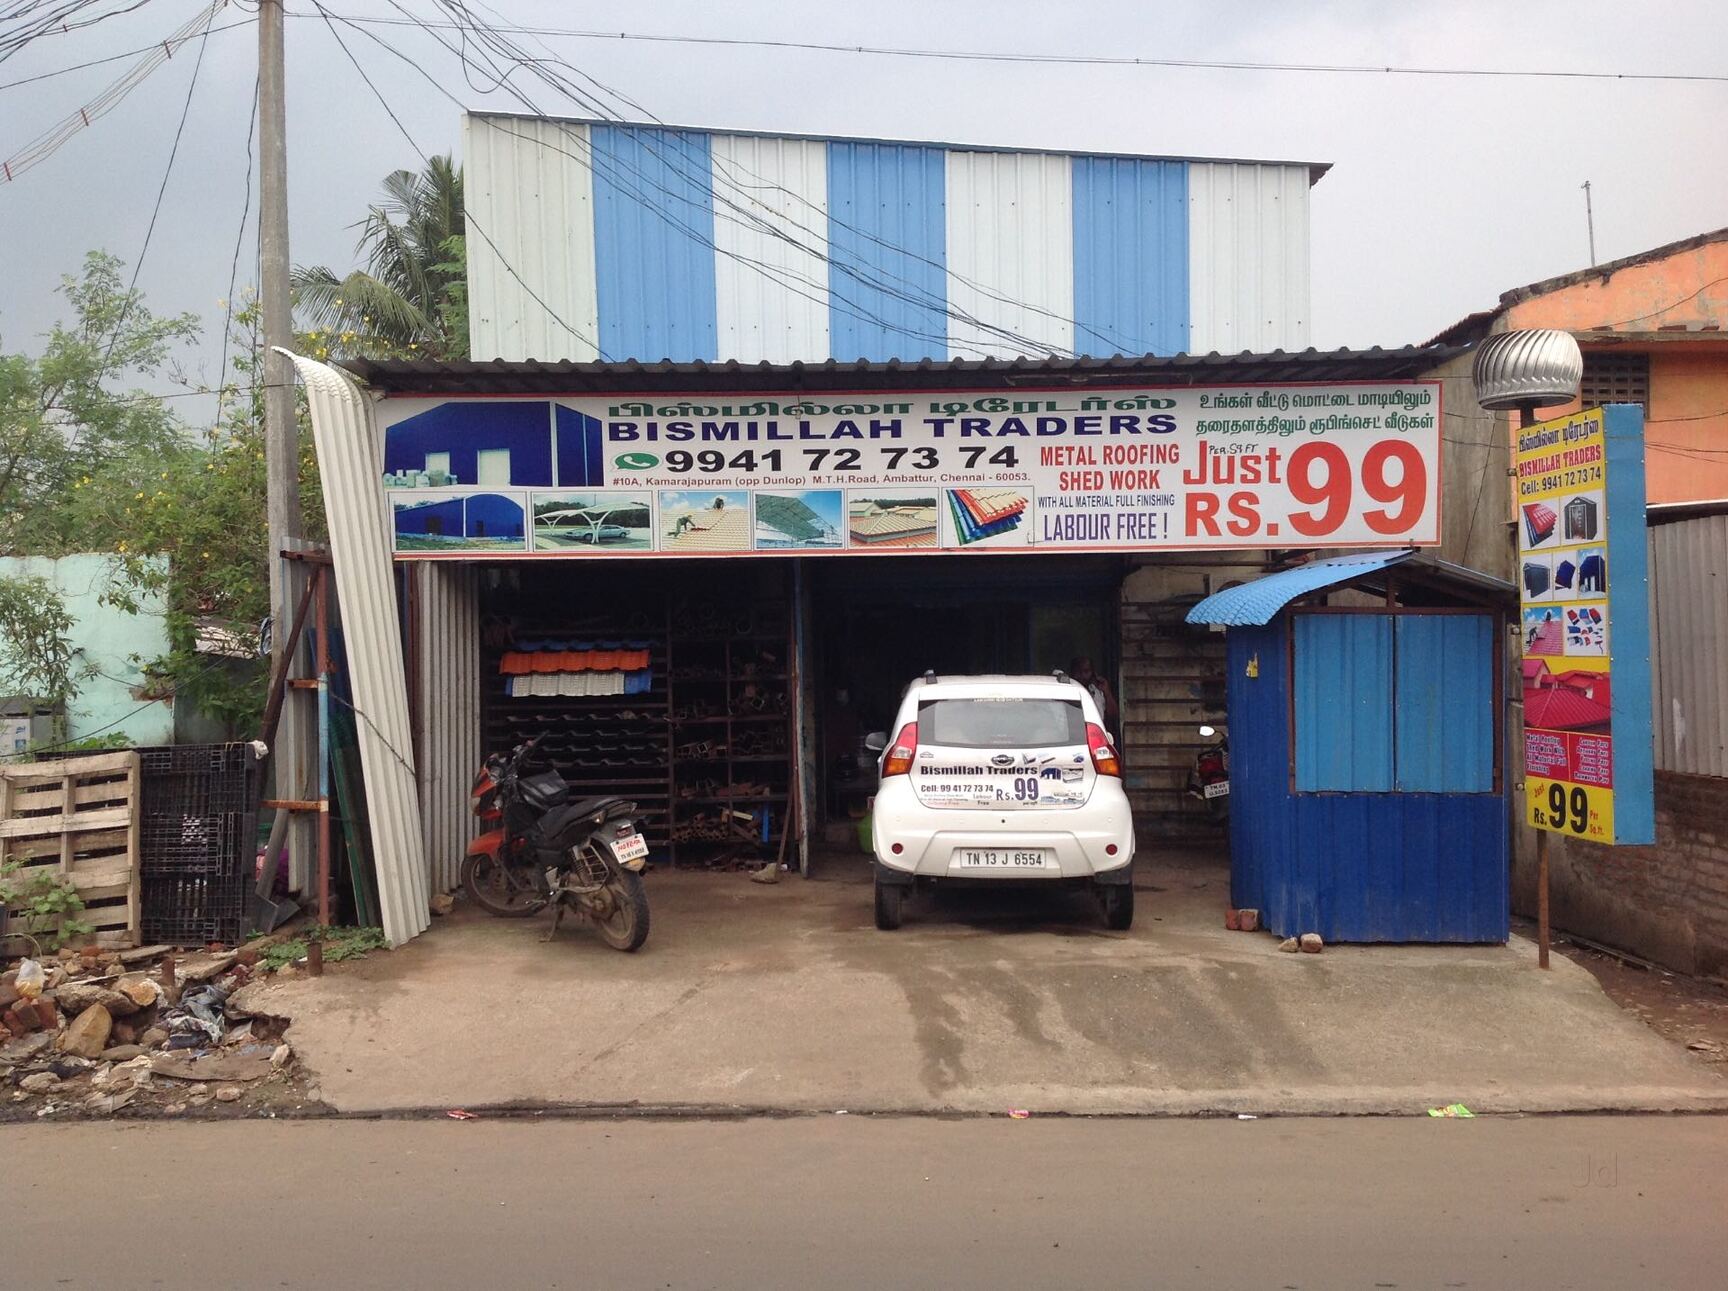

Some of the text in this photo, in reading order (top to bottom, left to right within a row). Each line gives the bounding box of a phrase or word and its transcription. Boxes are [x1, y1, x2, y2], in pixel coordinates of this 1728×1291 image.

[608, 401, 914, 417] பிஸ்மில்லா
[1200, 389, 1431, 411] உங்கள் வீட்டு மொட்டை மாடியிலும்
[608, 415, 1177, 441] BISMILLAH TRADERS
[1196, 415, 1306, 437] தரைதளத்திலும்
[1385, 411, 1435, 432] வீடுகள்
[665, 445, 1019, 473] 9941 72 73 74
[1041, 443, 1179, 466] METAL ROOFING
[1183, 440, 1282, 485] Just
[1519, 444, 1601, 477] BISMILLAH TRADERS
[613, 477, 642, 487] #10A,
[646, 477, 732, 487] Kamarajapuram
[735, 476, 760, 487] (opp
[763, 475, 806, 486] Dunlop)
[883, 473, 937, 484] Ambattur,
[940, 473, 985, 482] Chennai
[1059, 469, 1161, 491] SHED WORK
[1185, 439, 1427, 537] RS. 99
[1521, 466, 1601, 495] Cell: 9941 72 73 74
[1038, 494, 1175, 508] WITH ALL MATERIAL FULL FINISHING
[1044, 513, 1111, 541] LABOUR
[1117, 512, 1157, 540] FREE
[920, 765, 1038, 775] Bismillah Traders
[974, 784, 983, 793] 73
[985, 784, 994, 793] 74
[996, 777, 1039, 801] Rs. 99
[1534, 783, 1588, 834] Rs. 99
[966, 853, 1042, 865] TN 13 J 6554
